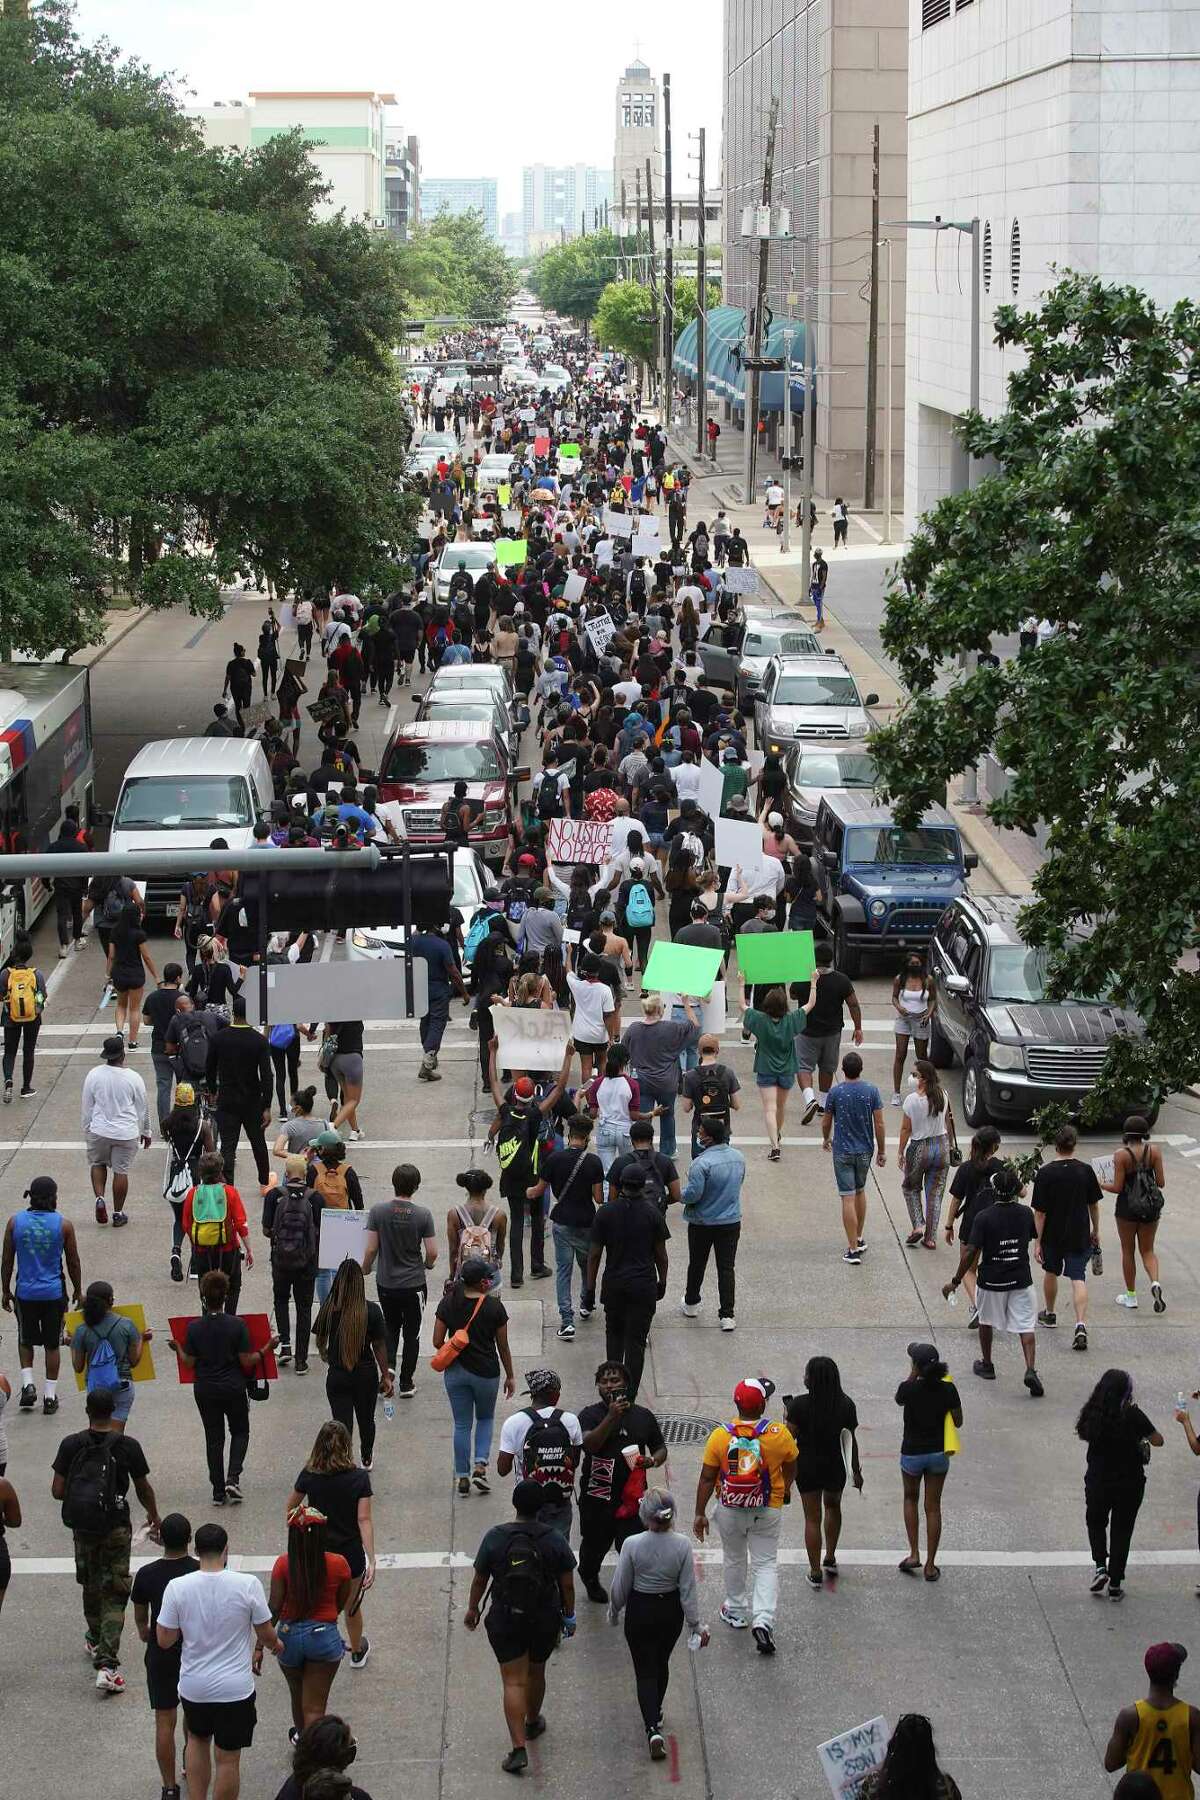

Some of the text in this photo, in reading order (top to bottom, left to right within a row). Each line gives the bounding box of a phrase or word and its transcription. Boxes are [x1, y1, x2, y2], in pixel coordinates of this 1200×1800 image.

[587, 616, 612, 631] JUSTICE
[550, 819, 615, 843] NO JUSTICE
[548, 839, 612, 863] NO PEACE
[537, 1446, 563, 1454] MIAMI
[542, 1450, 566, 1460] HEAT
[826, 1724, 874, 1761] IS MY
[844, 1748, 876, 1776] SON
[1148, 1738, 1177, 1775] 4
